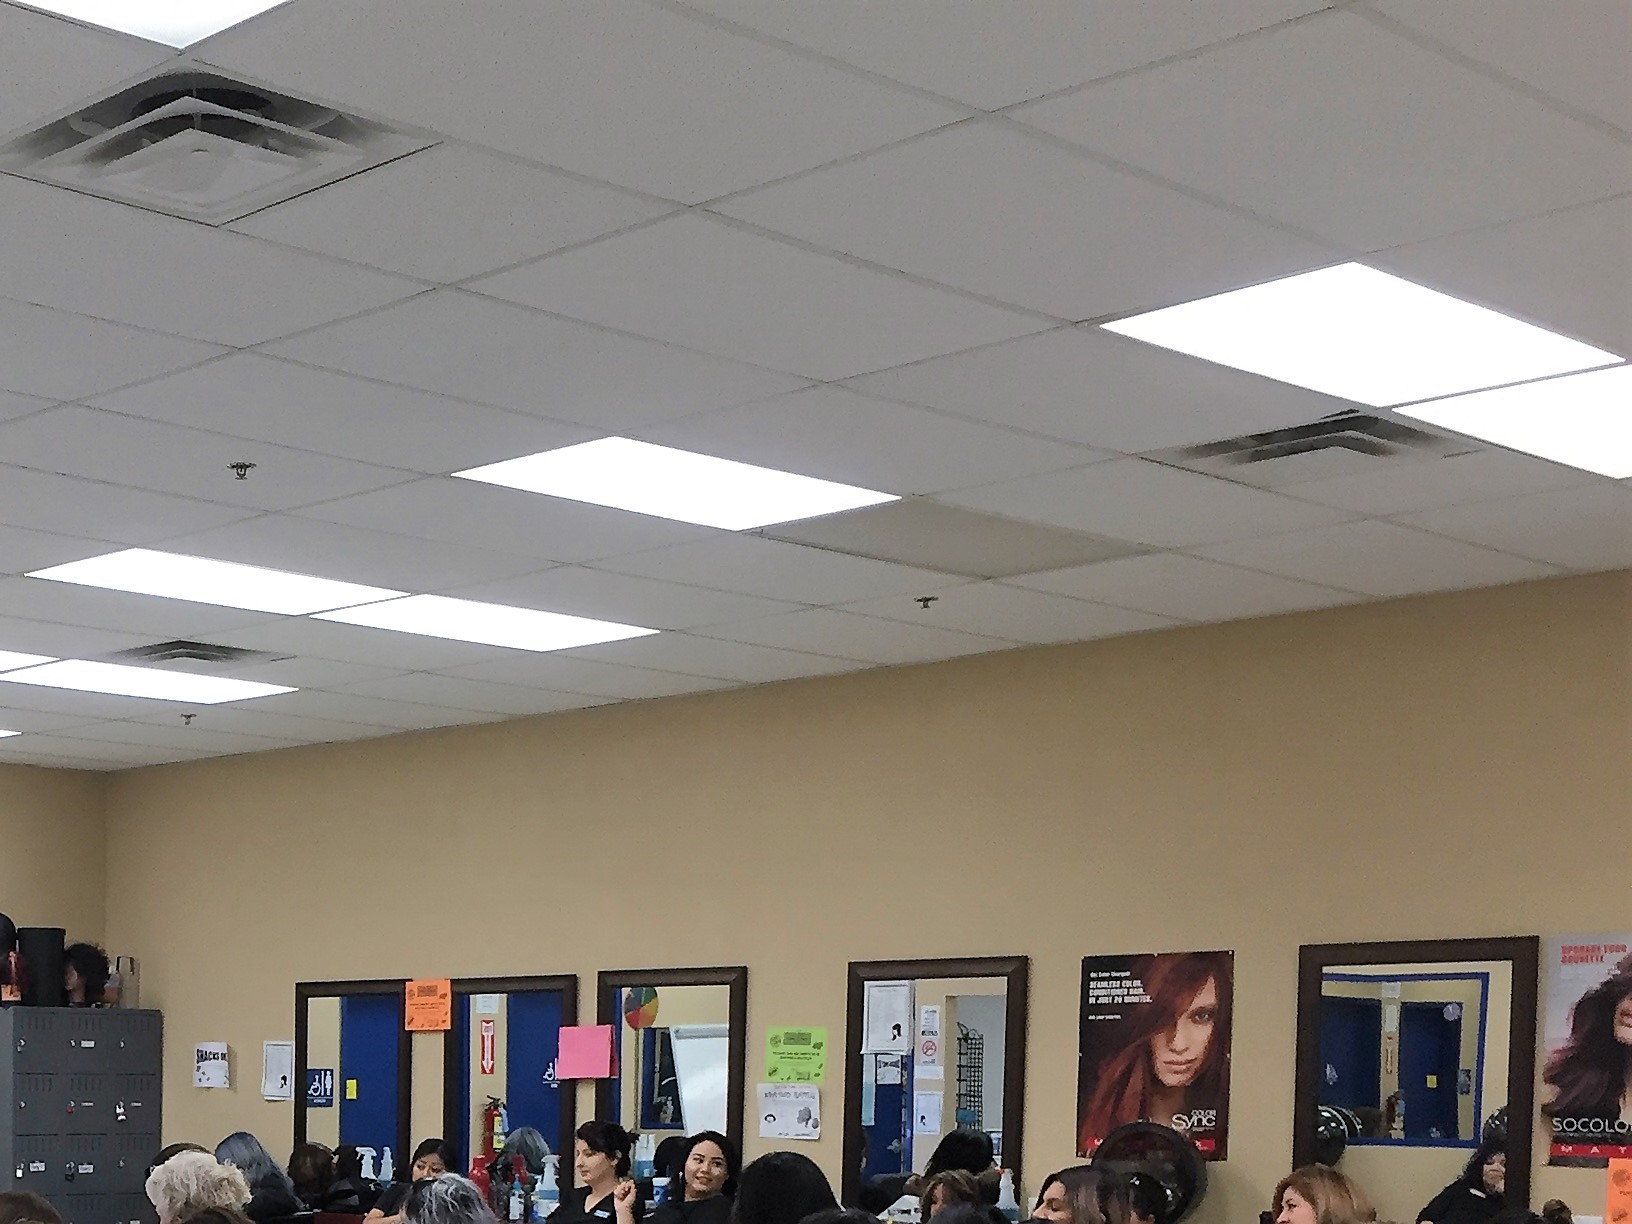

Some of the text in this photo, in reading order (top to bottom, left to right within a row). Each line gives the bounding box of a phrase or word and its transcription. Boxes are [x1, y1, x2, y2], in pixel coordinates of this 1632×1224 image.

[1191, 1109, 1217, 1117] COLOR
[1172, 1113, 1216, 1132] Sync
[1551, 1117, 1632, 1133] SOCOLO
